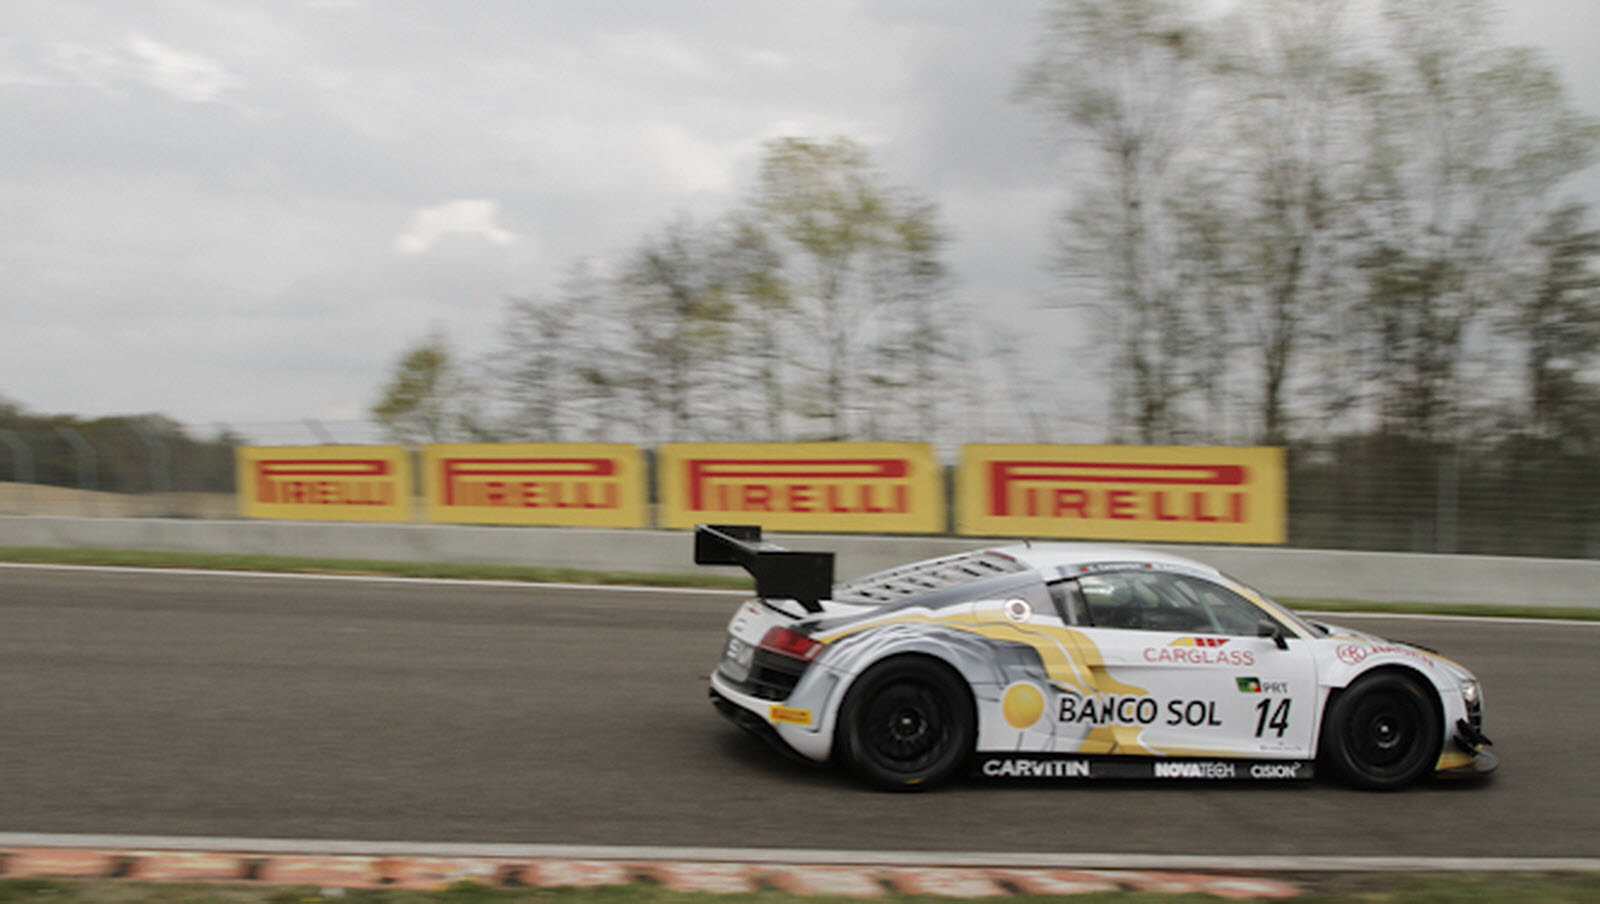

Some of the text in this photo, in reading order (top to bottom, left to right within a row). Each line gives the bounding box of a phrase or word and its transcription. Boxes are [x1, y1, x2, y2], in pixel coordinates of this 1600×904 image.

[687, 459, 909, 514] PIRELLI
[988, 460, 1249, 523] PIRELLI
[1143, 647, 1255, 666] CARGLASS
[1058, 697, 1222, 726] BANCO SOL
[1254, 698, 1292, 738] 14
[983, 759, 1090, 777] CARVITIN
[1154, 762, 1235, 778] NOVATECH
